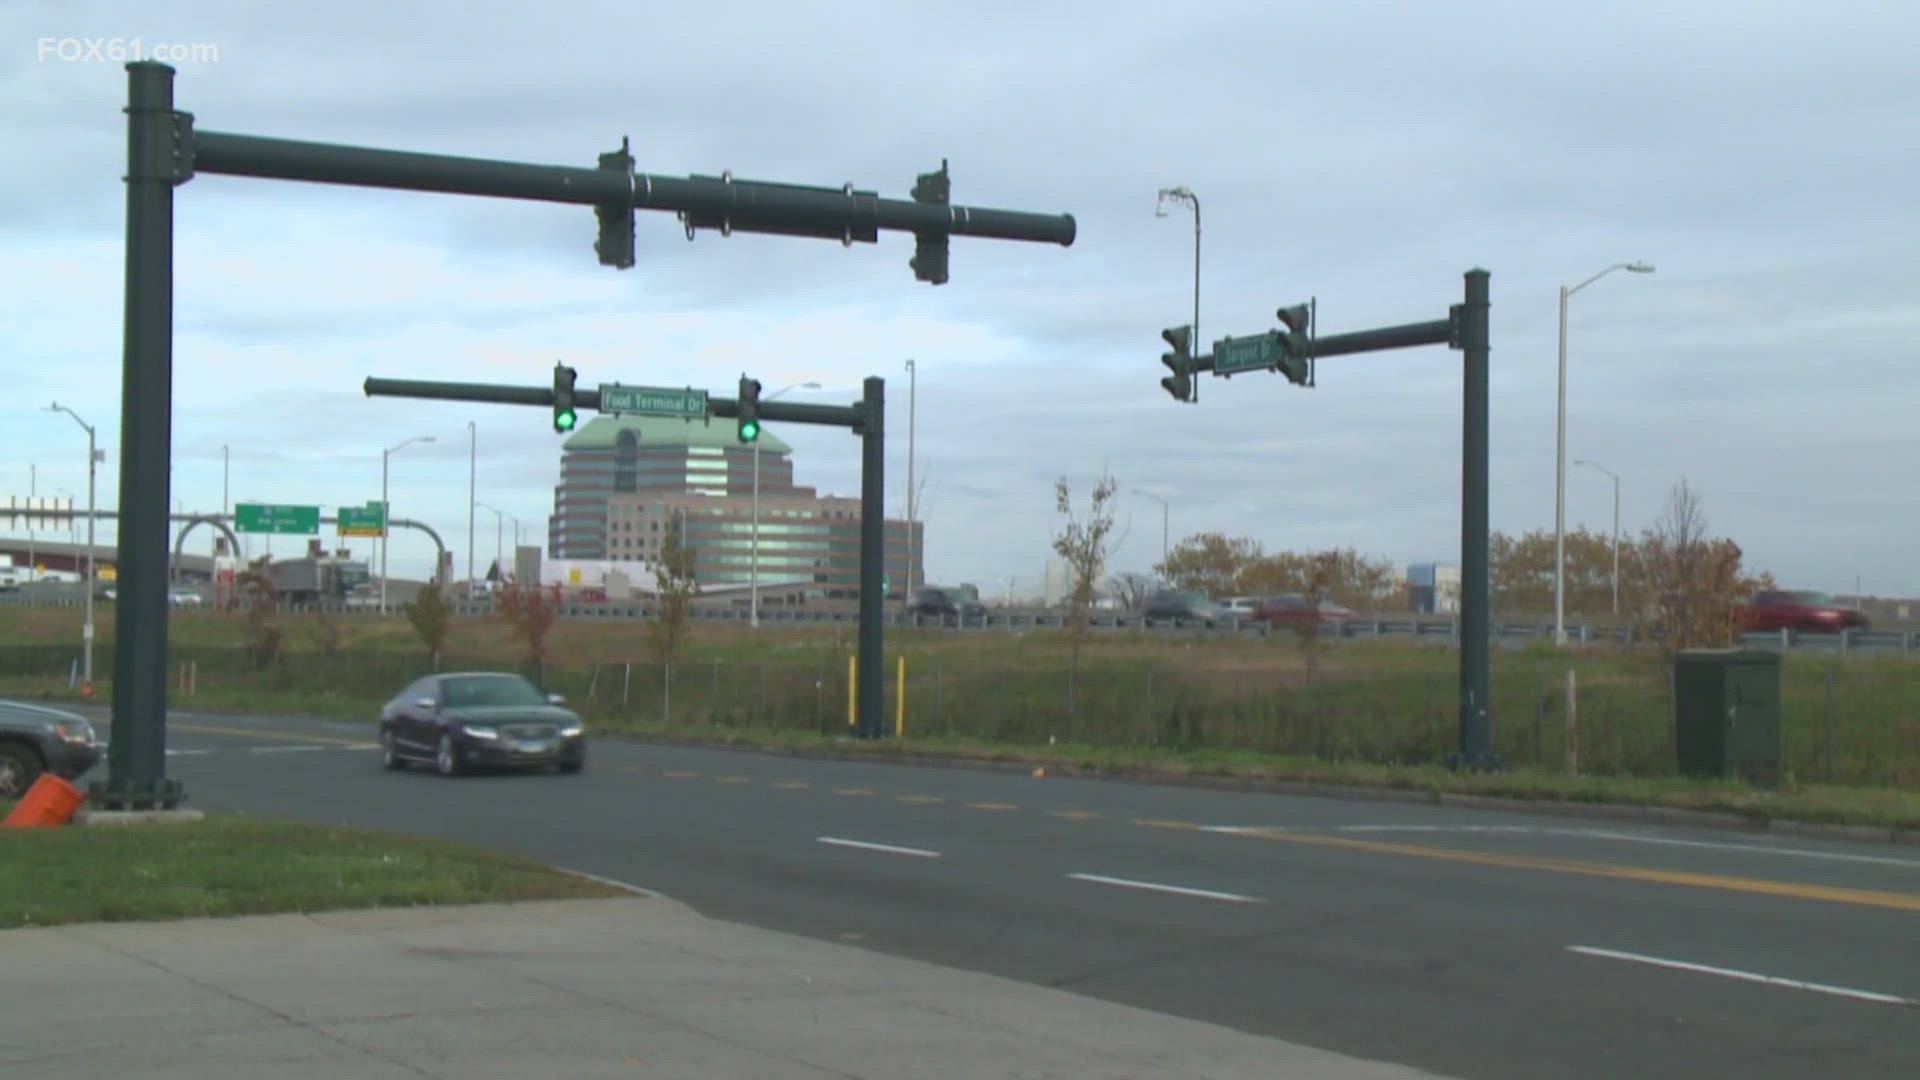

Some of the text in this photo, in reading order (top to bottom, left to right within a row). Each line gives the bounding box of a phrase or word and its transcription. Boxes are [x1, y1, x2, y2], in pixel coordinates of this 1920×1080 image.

[605, 392, 702, 411] Food Terminal Dr
